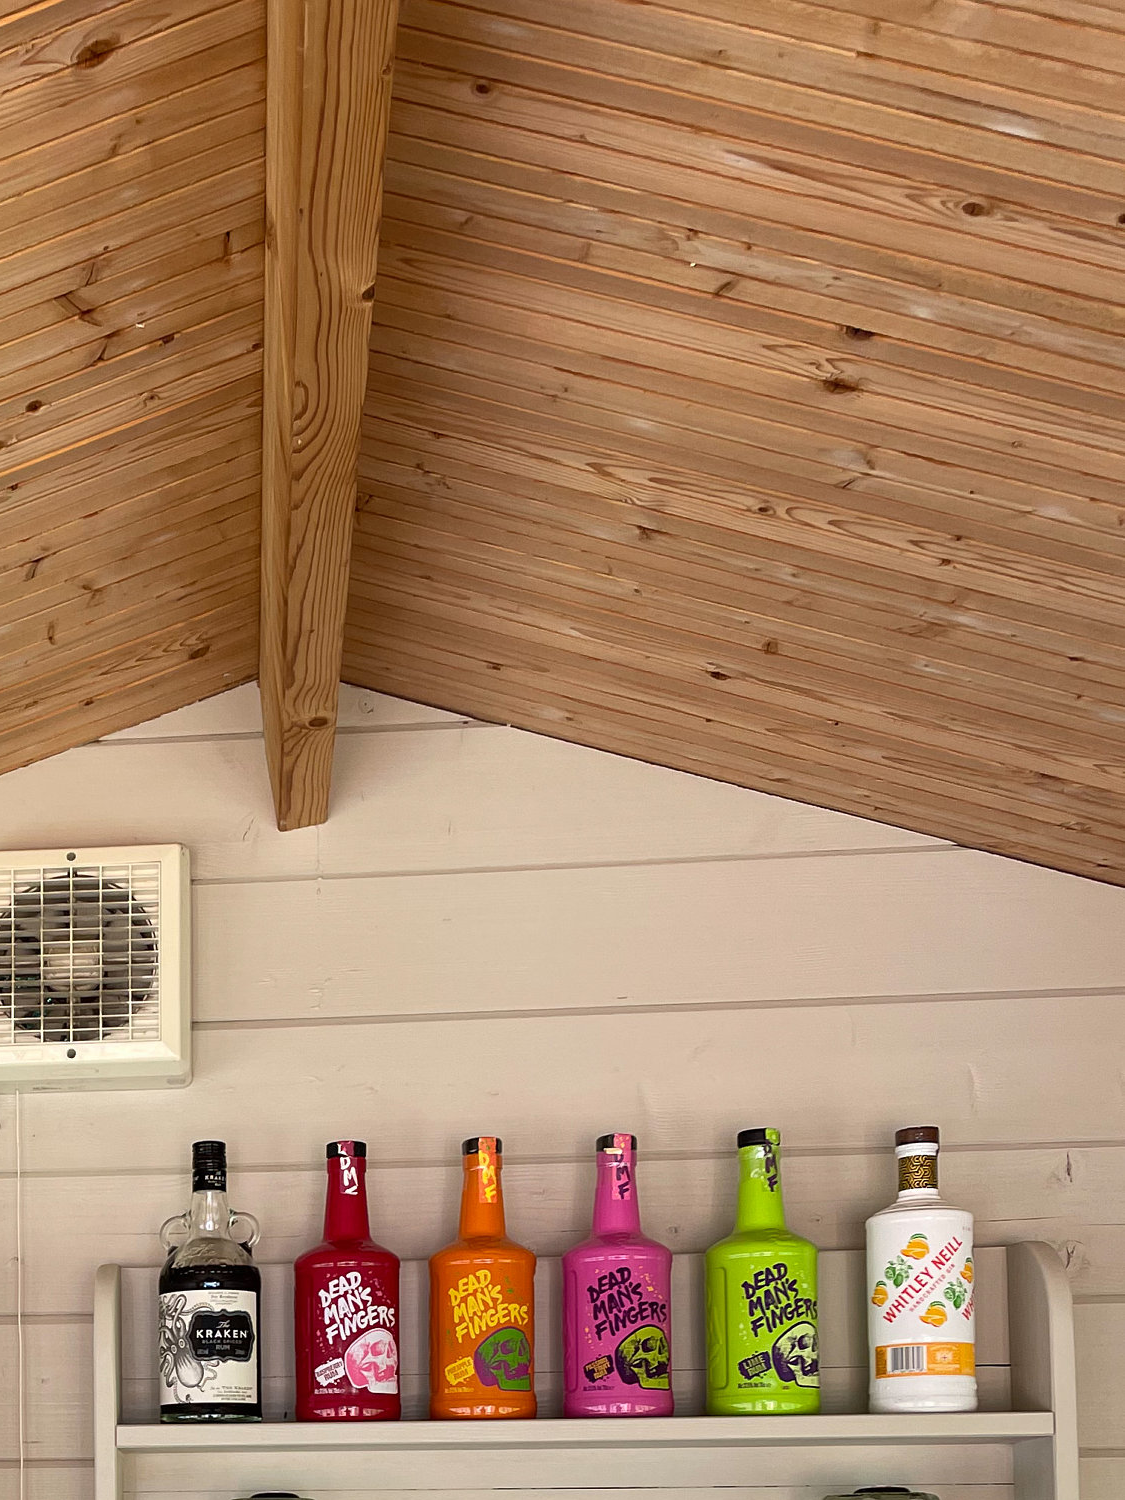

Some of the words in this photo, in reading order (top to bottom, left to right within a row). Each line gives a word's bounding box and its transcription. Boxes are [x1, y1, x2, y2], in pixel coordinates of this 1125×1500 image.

[319, 1271, 361, 1308] DEAD
[448, 1269, 491, 1306] DEAD
[587, 1266, 631, 1304] DEAD
[741, 1263, 788, 1300] DEAD
[748, 1279, 798, 1319] MAN'S
[883, 1267, 933, 1324] WHITLEY
[931, 1236, 963, 1271] NEILL
[323, 1286, 372, 1325] MAN'S
[453, 1284, 503, 1324] MAN'S
[593, 1282, 643, 1321] MAN'S
[595, 1301, 667, 1341] FINGERS
[750, 1298, 818, 1338] FINGERS
[196, 1329, 247, 1339] KRAKEN
[325, 1306, 395, 1345] FINGERS
[455, 1303, 529, 1344] FINGERS
